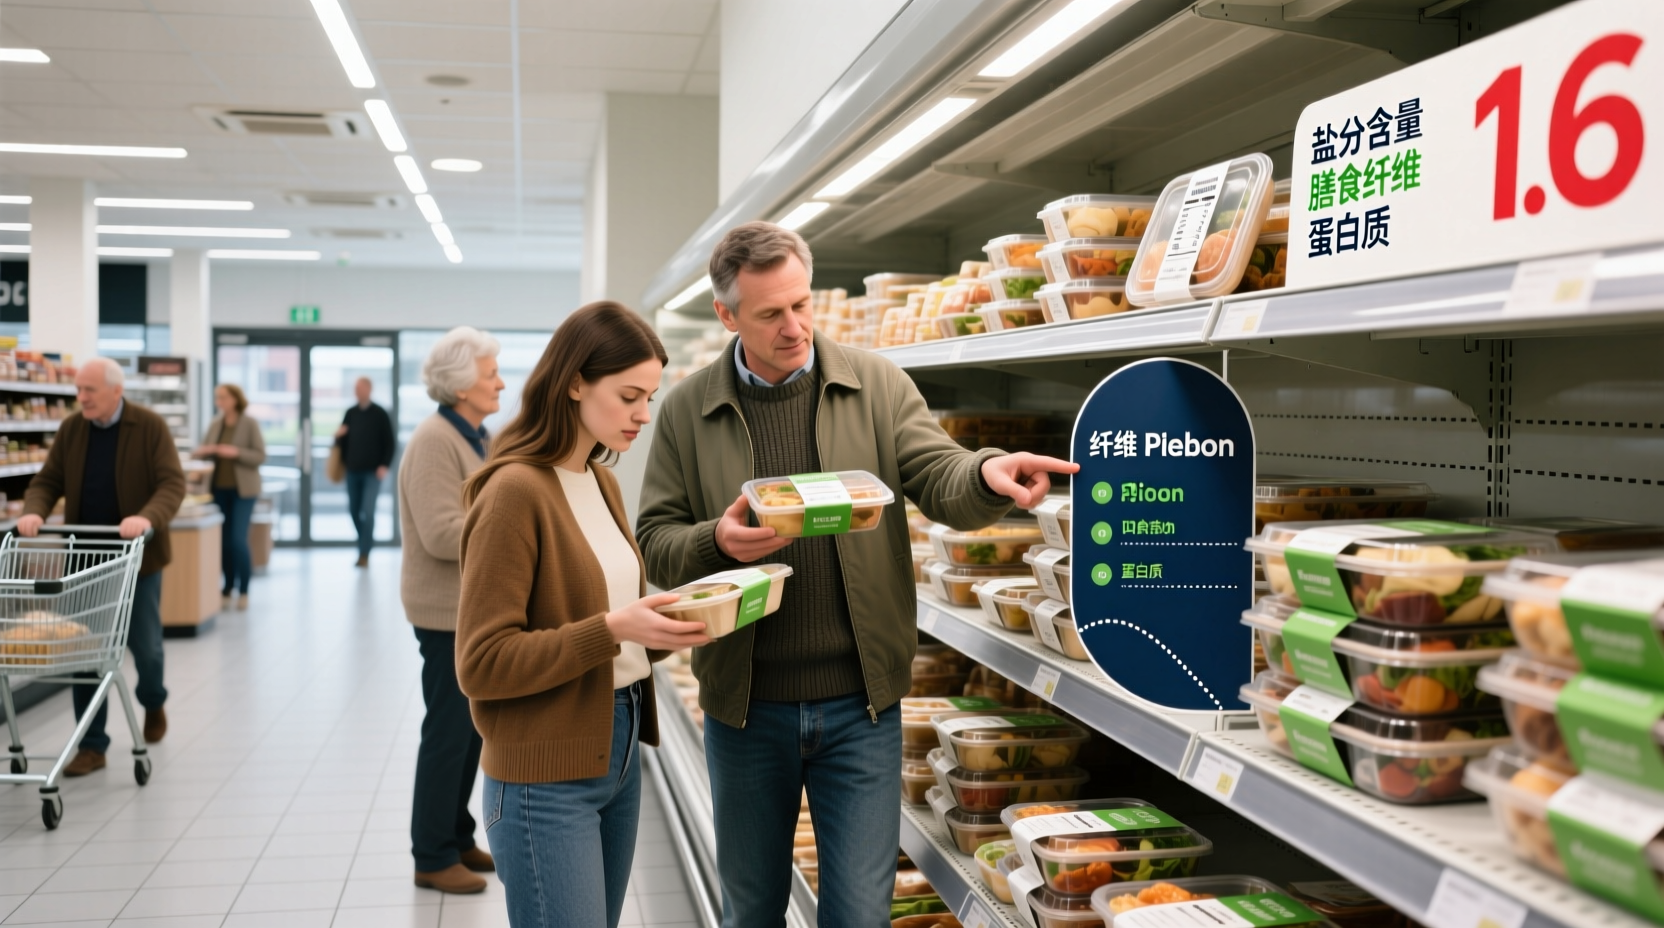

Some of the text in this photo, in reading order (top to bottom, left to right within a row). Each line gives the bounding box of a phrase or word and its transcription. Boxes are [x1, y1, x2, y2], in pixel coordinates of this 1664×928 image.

[1310, 97, 1424, 165] 盐分含量
[1474, 33, 1645, 221] 1.6
[1307, 148, 1422, 212] 膳食纤维
[1308, 204, 1391, 259] 蛋白质
[1089, 430, 1234, 458] 纤维 Piebon
